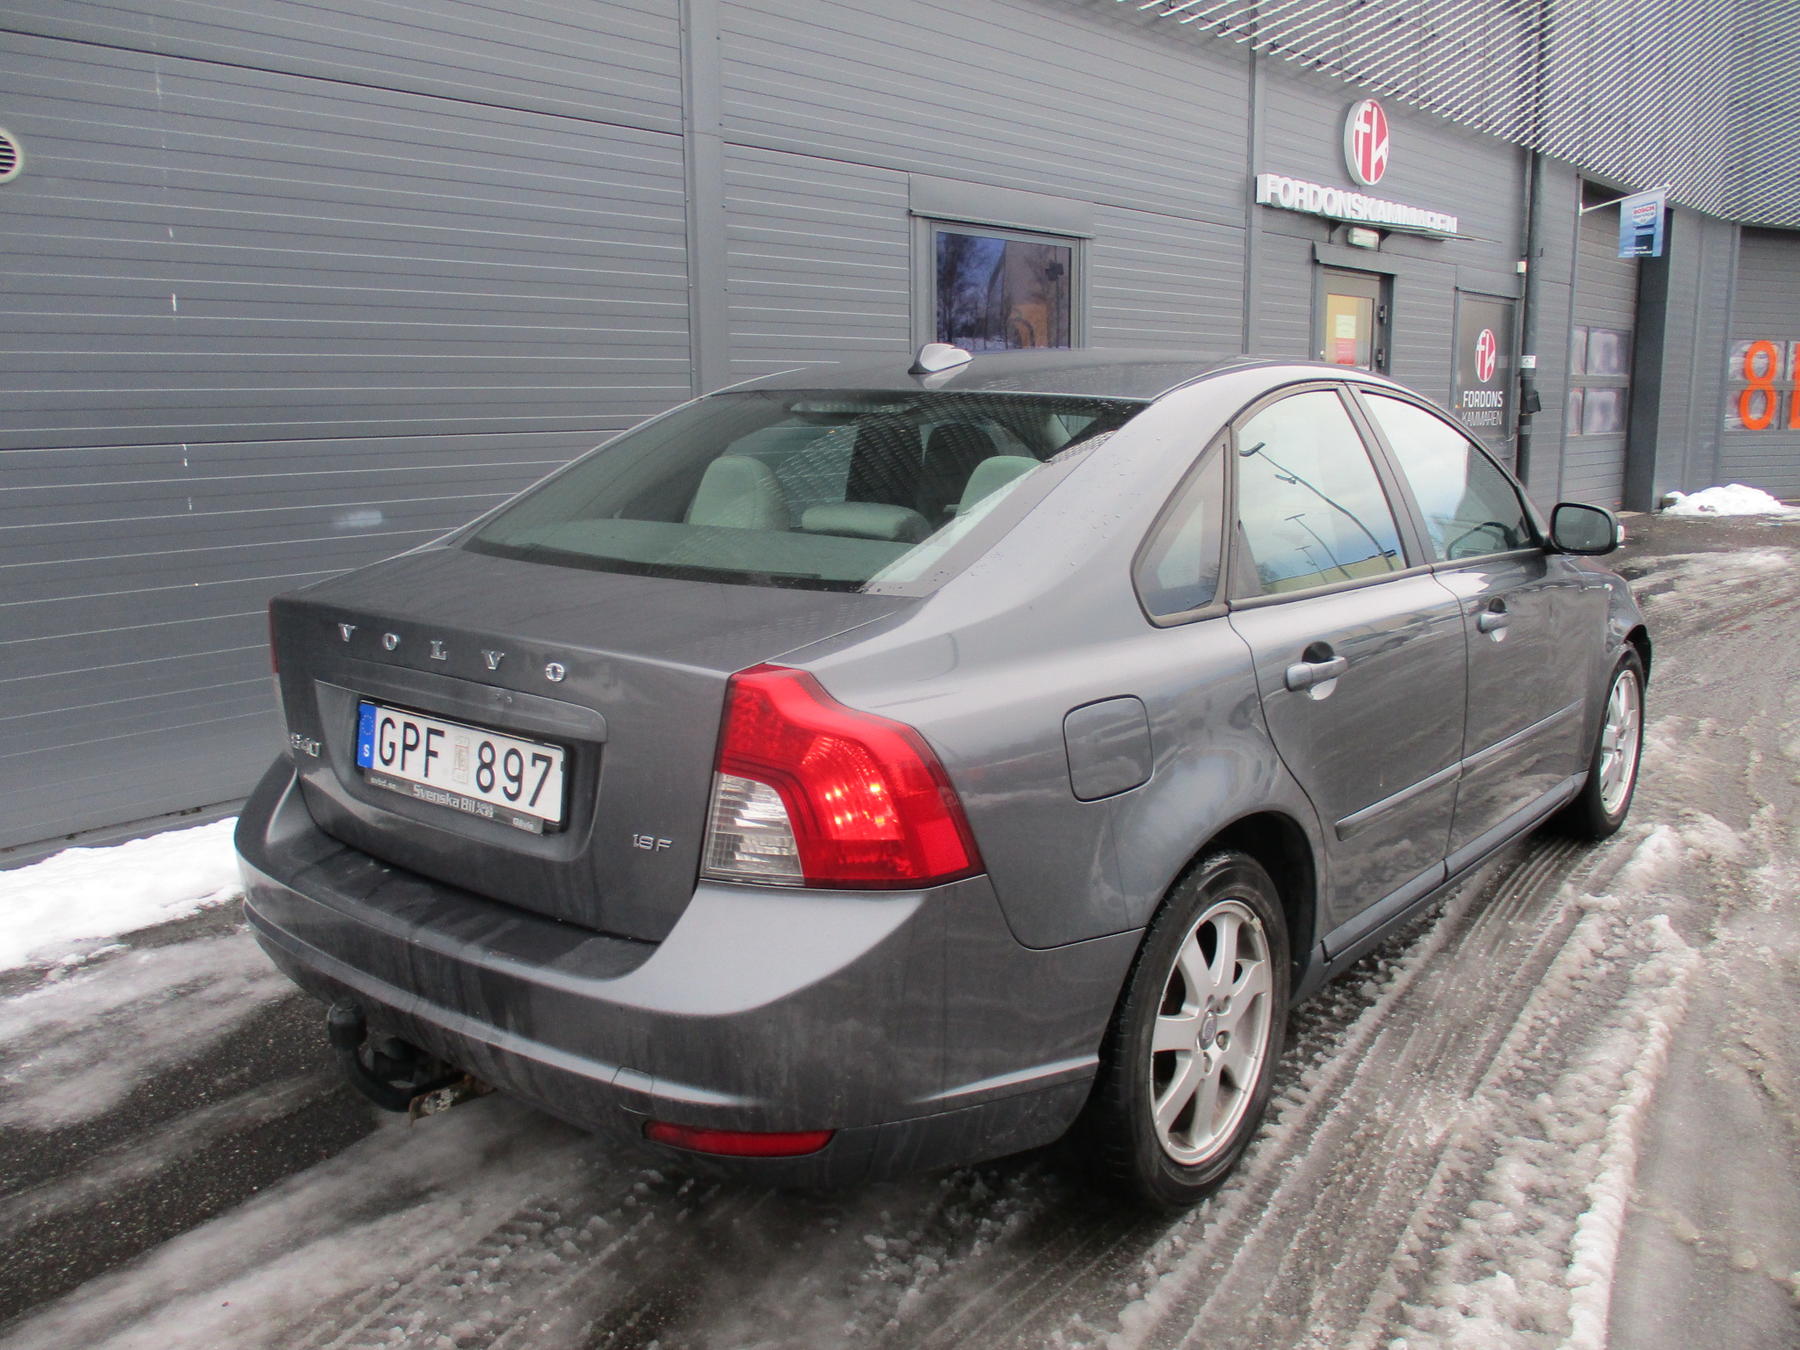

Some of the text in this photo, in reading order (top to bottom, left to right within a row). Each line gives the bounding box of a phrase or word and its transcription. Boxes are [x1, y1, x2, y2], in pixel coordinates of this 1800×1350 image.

[1463, 390, 1504, 408] FORDONS
[1462, 410, 1503, 426] KAMMAREN
[338, 623, 565, 682] VOLVO
[363, 744, 370, 757] S
[379, 716, 445, 778] GPF
[476, 740, 554, 807] 897
[413, 784, 460, 808] Svenska
[461, 797, 476, 815] Bil
